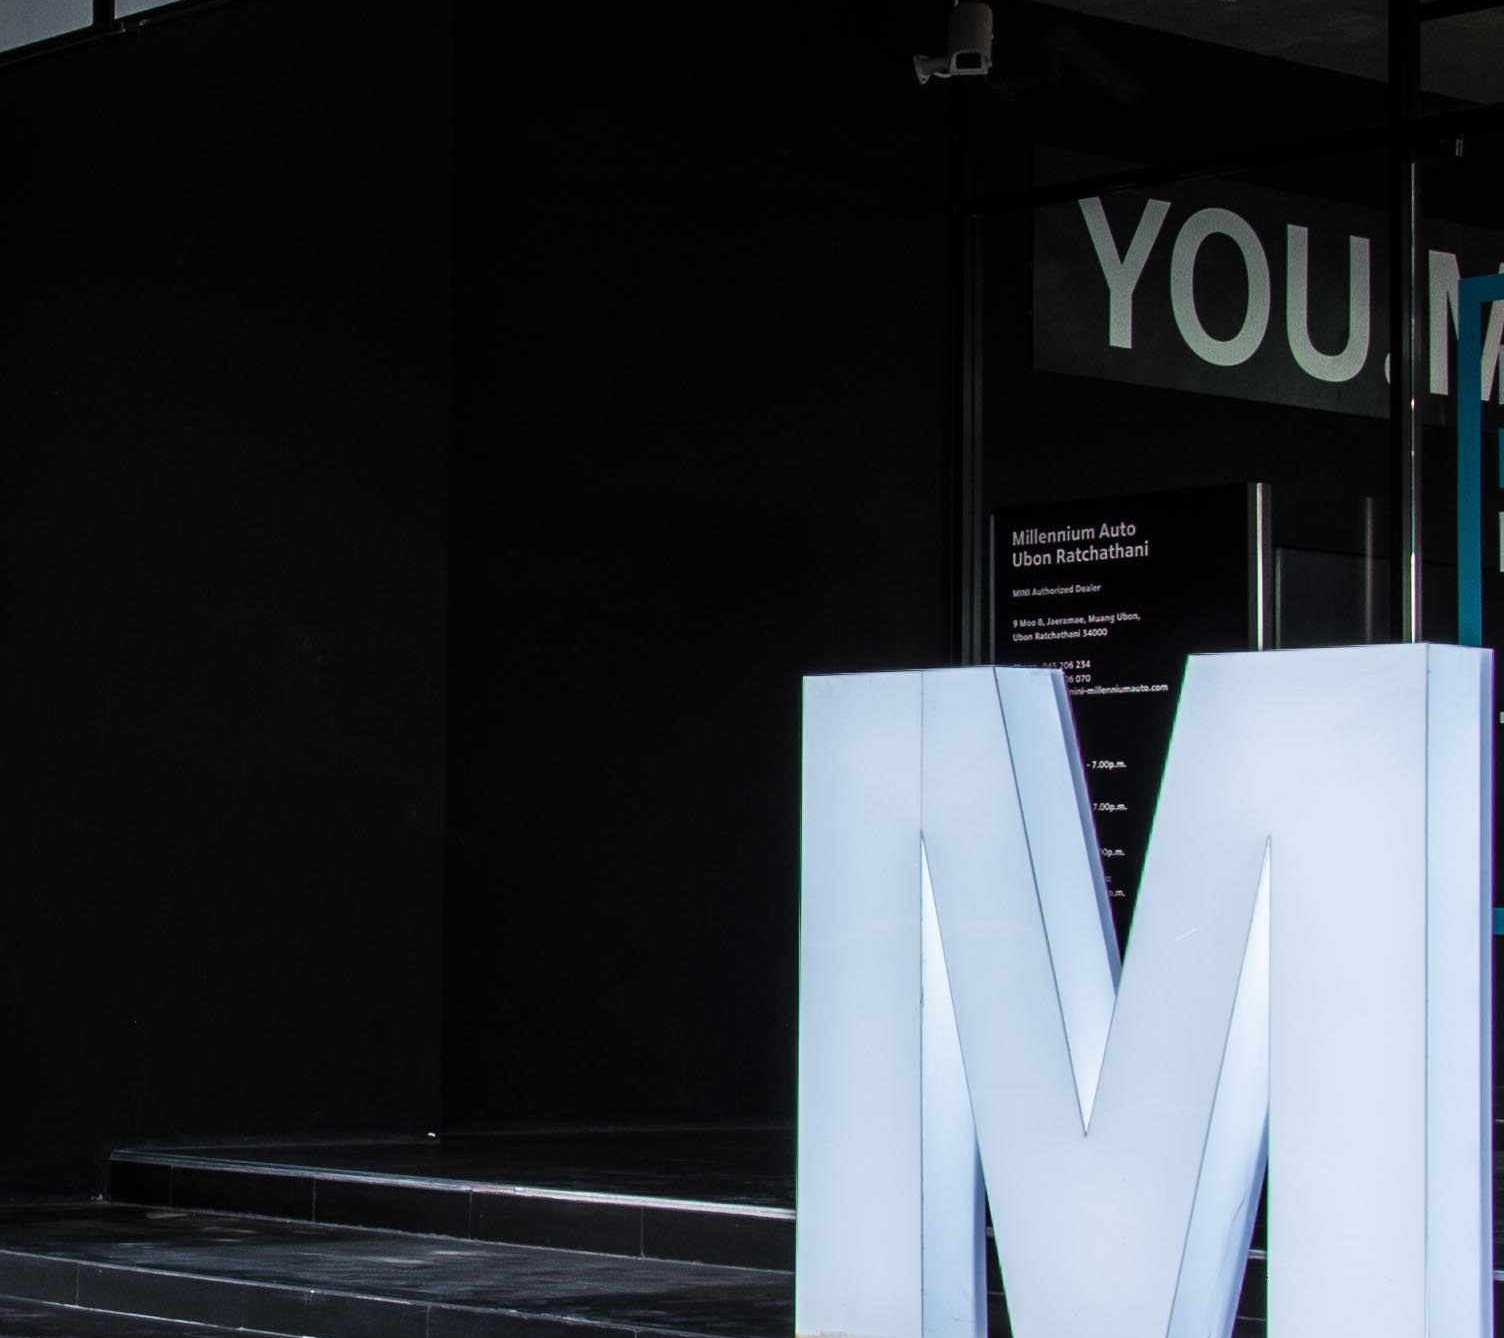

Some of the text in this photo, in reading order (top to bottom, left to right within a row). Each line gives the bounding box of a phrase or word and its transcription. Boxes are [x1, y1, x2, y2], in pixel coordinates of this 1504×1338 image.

[1012, 522, 1136, 546] Millennium Auto
[1012, 540, 1149, 567] Ubon Ratchathani
[1012, 583, 1102, 597] MINI Authorized Dealer
[1019, 619, 1036, 627] Moo
[1088, 614, 1115, 624] Muang
[1012, 627, 1108, 641] Ubon Ratchathani 34000
[1075, 660, 1091, 669] 234
[1075, 674, 1091, 683] 070
